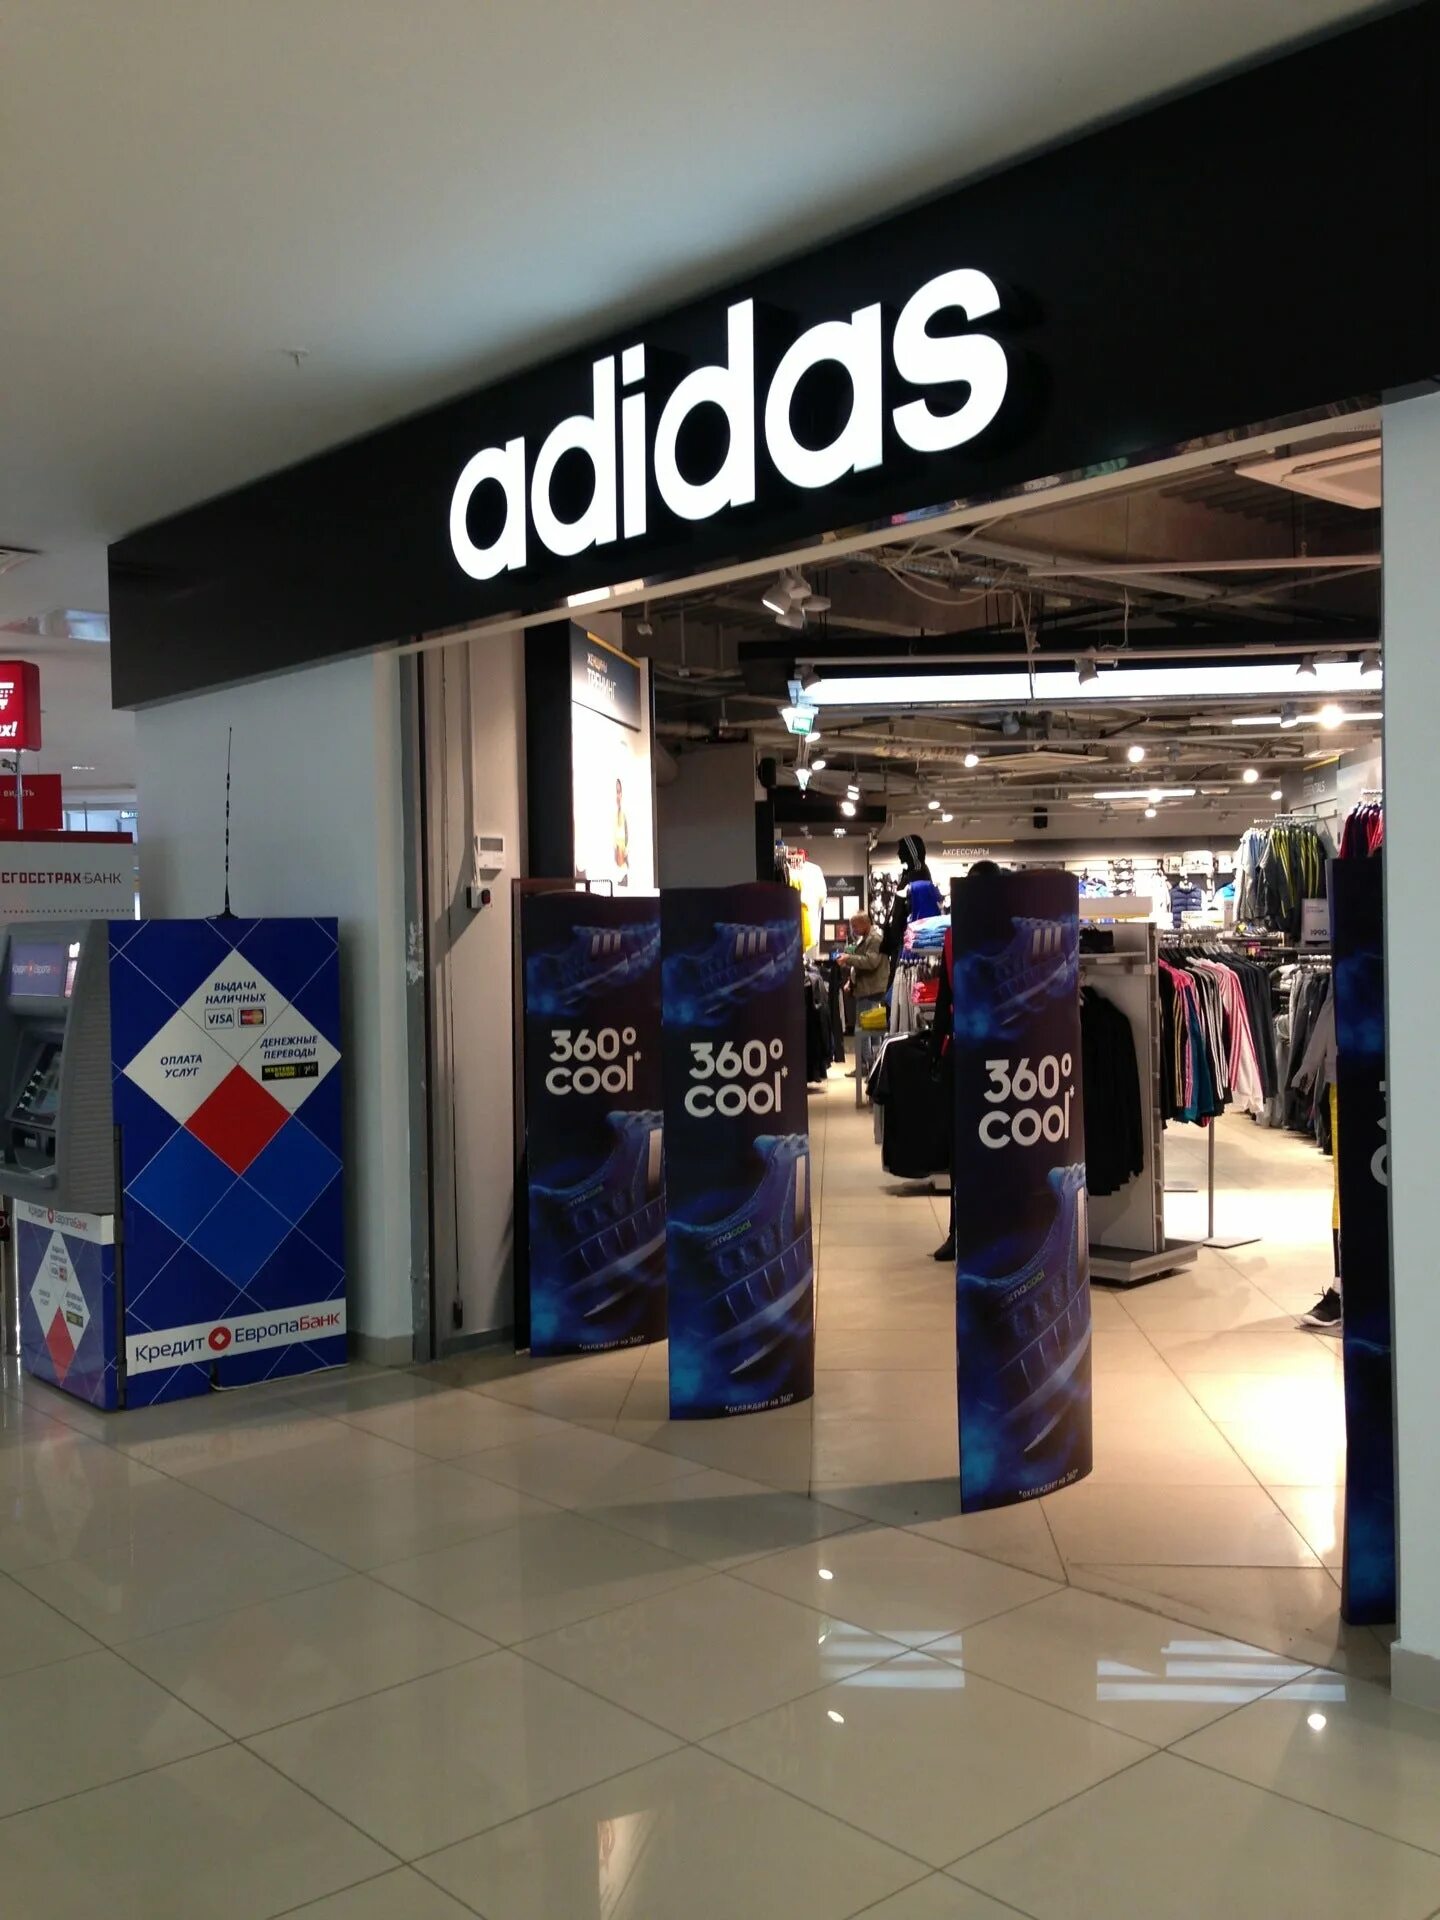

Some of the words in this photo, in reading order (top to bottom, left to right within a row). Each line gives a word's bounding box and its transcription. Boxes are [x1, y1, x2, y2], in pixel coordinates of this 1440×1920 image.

[450, 268, 1009, 580] adidas
[942, 847, 990, 857] АКСЕССУАРЫ
[214, 981, 257, 992] ВЫДАЧА
[205, 993, 267, 1004] НАЛИЧНЫХ
[208, 1013, 233, 1025] VISA
[260, 1035, 318, 1049] ДЕНЕЖНЫЕ
[550, 1026, 637, 1062] 360°
[160, 1054, 202, 1066] ОПЛАТА
[263, 1048, 316, 1060] ПЕРЕВОДЫ
[689, 1038, 784, 1079] 360°
[165, 1067, 200, 1078] УСЛУГ
[984, 1052, 1072, 1103] 360°
[135, 1336, 205, 1363] Кредит
[235, 1312, 340, 1343] ЕвропаБанк
